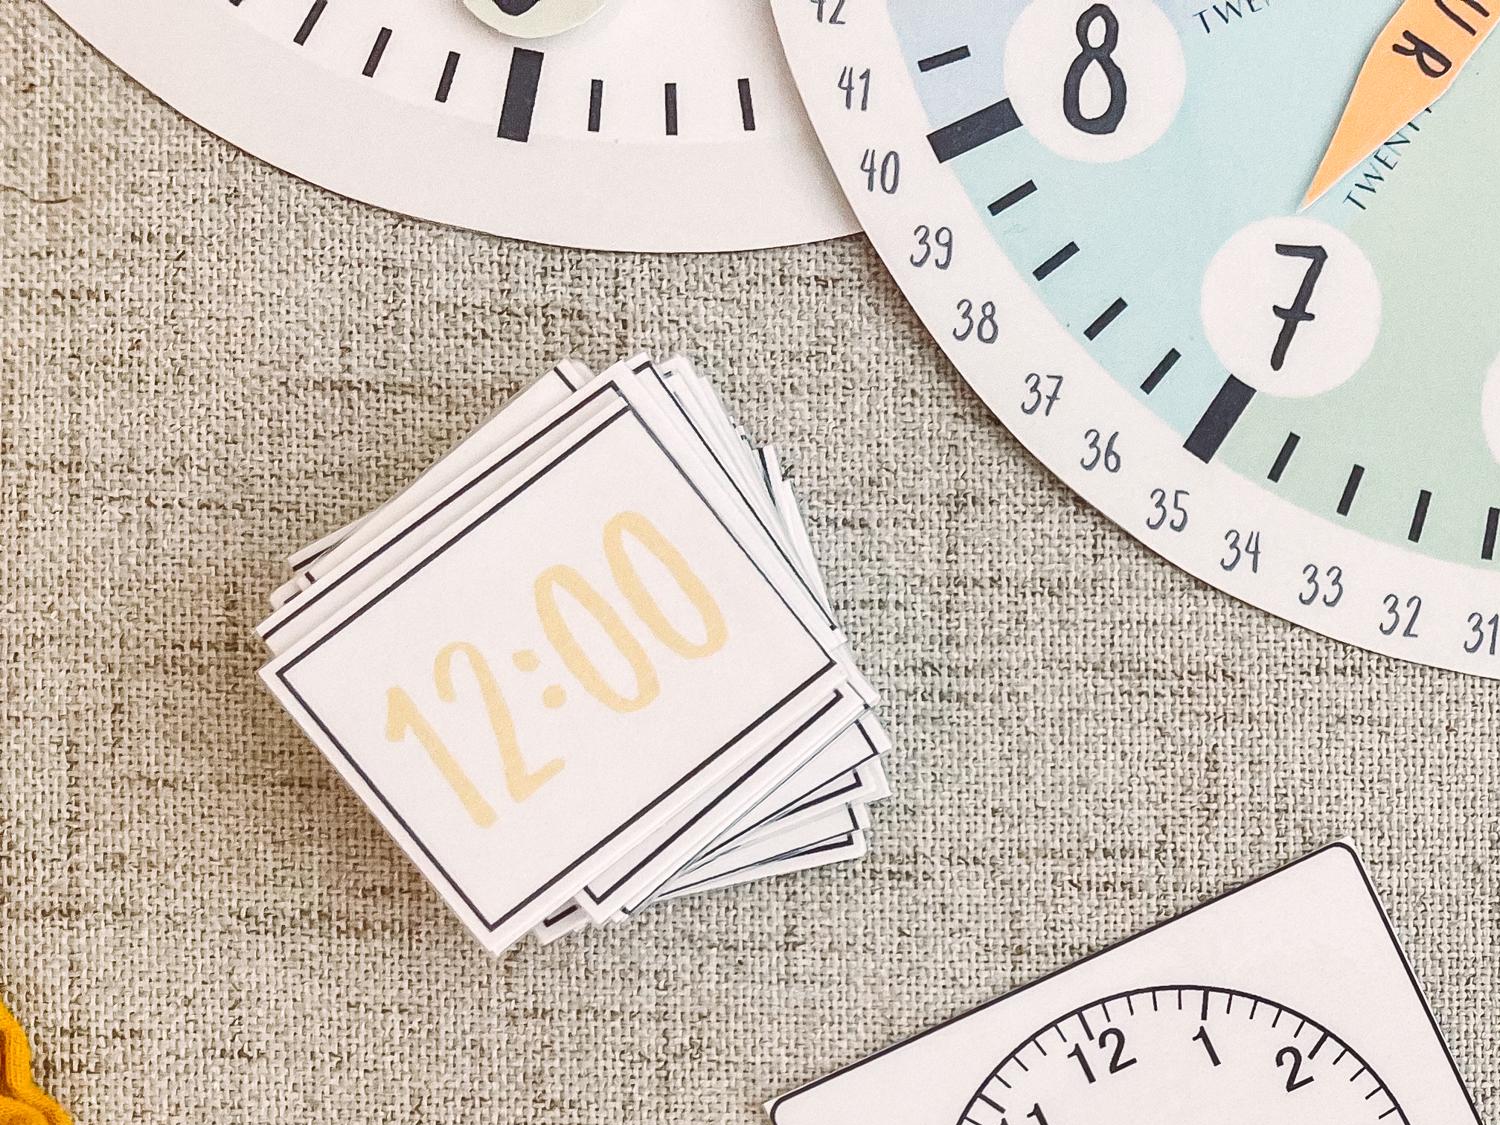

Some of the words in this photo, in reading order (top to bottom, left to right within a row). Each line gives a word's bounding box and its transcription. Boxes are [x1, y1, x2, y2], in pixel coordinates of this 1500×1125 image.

[838, 66, 870, 112] 41
[1063, 3, 1127, 135] 8
[860, 150, 900, 195] 40
[910, 225, 953, 270] 39
[953, 299, 999, 344] 38
[1270, 243, 1328, 371] 7
[1021, 373, 1064, 417] 37
[1080, 430, 1121, 473] 36
[1146, 488, 1190, 532] 35
[1220, 529, 1260, 573] 34
[1299, 564, 1343, 608] 33
[1379, 593, 1422, 638] 32
[1463, 612, 1500, 655] 31
[385, 510, 730, 829] 12:00
[1067, 1027, 1137, 1084] 12
[1193, 1026, 1221, 1066] 1
[1276, 1047, 1314, 1092] 2
